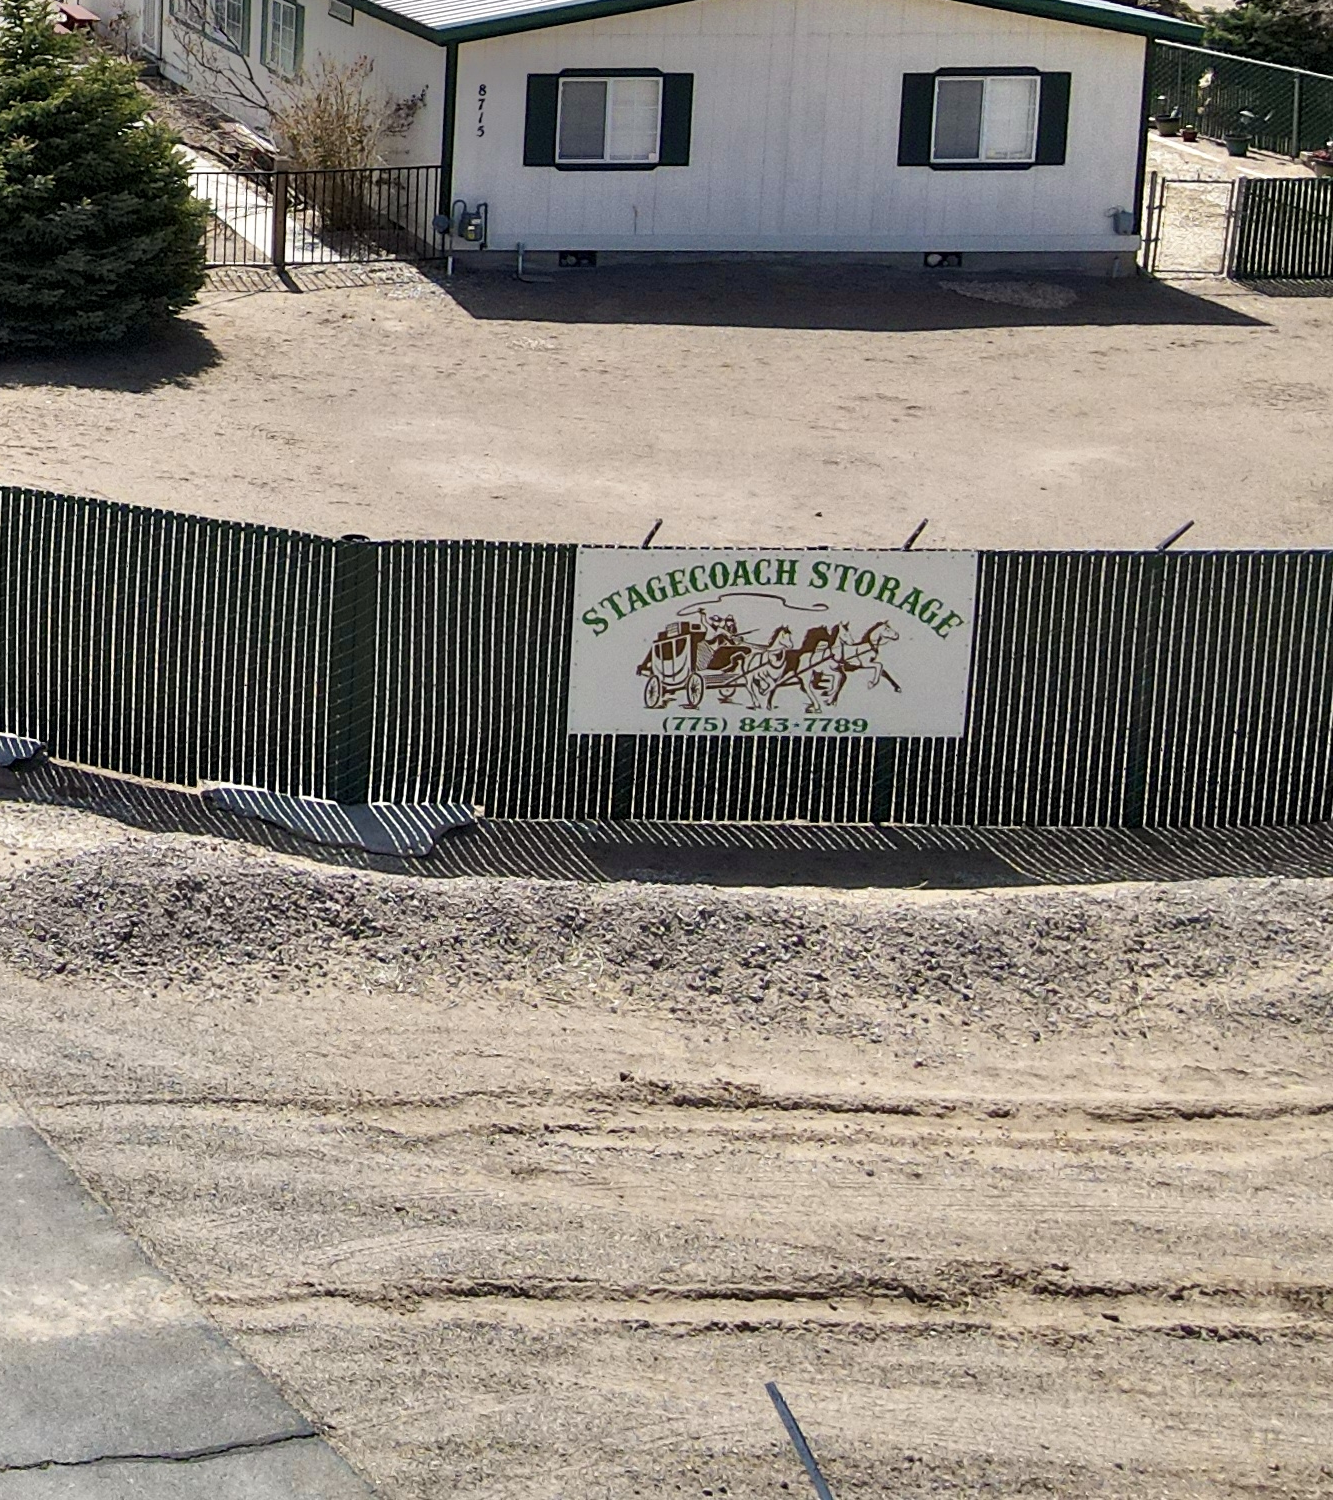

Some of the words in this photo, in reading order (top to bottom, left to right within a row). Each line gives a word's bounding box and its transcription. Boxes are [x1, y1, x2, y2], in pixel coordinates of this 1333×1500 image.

[476, 84, 487, 138] 8715
[581, 558, 798, 637] STAGECOACH
[808, 560, 965, 640] STORAGE
[662, 716, 728, 734] (775)
